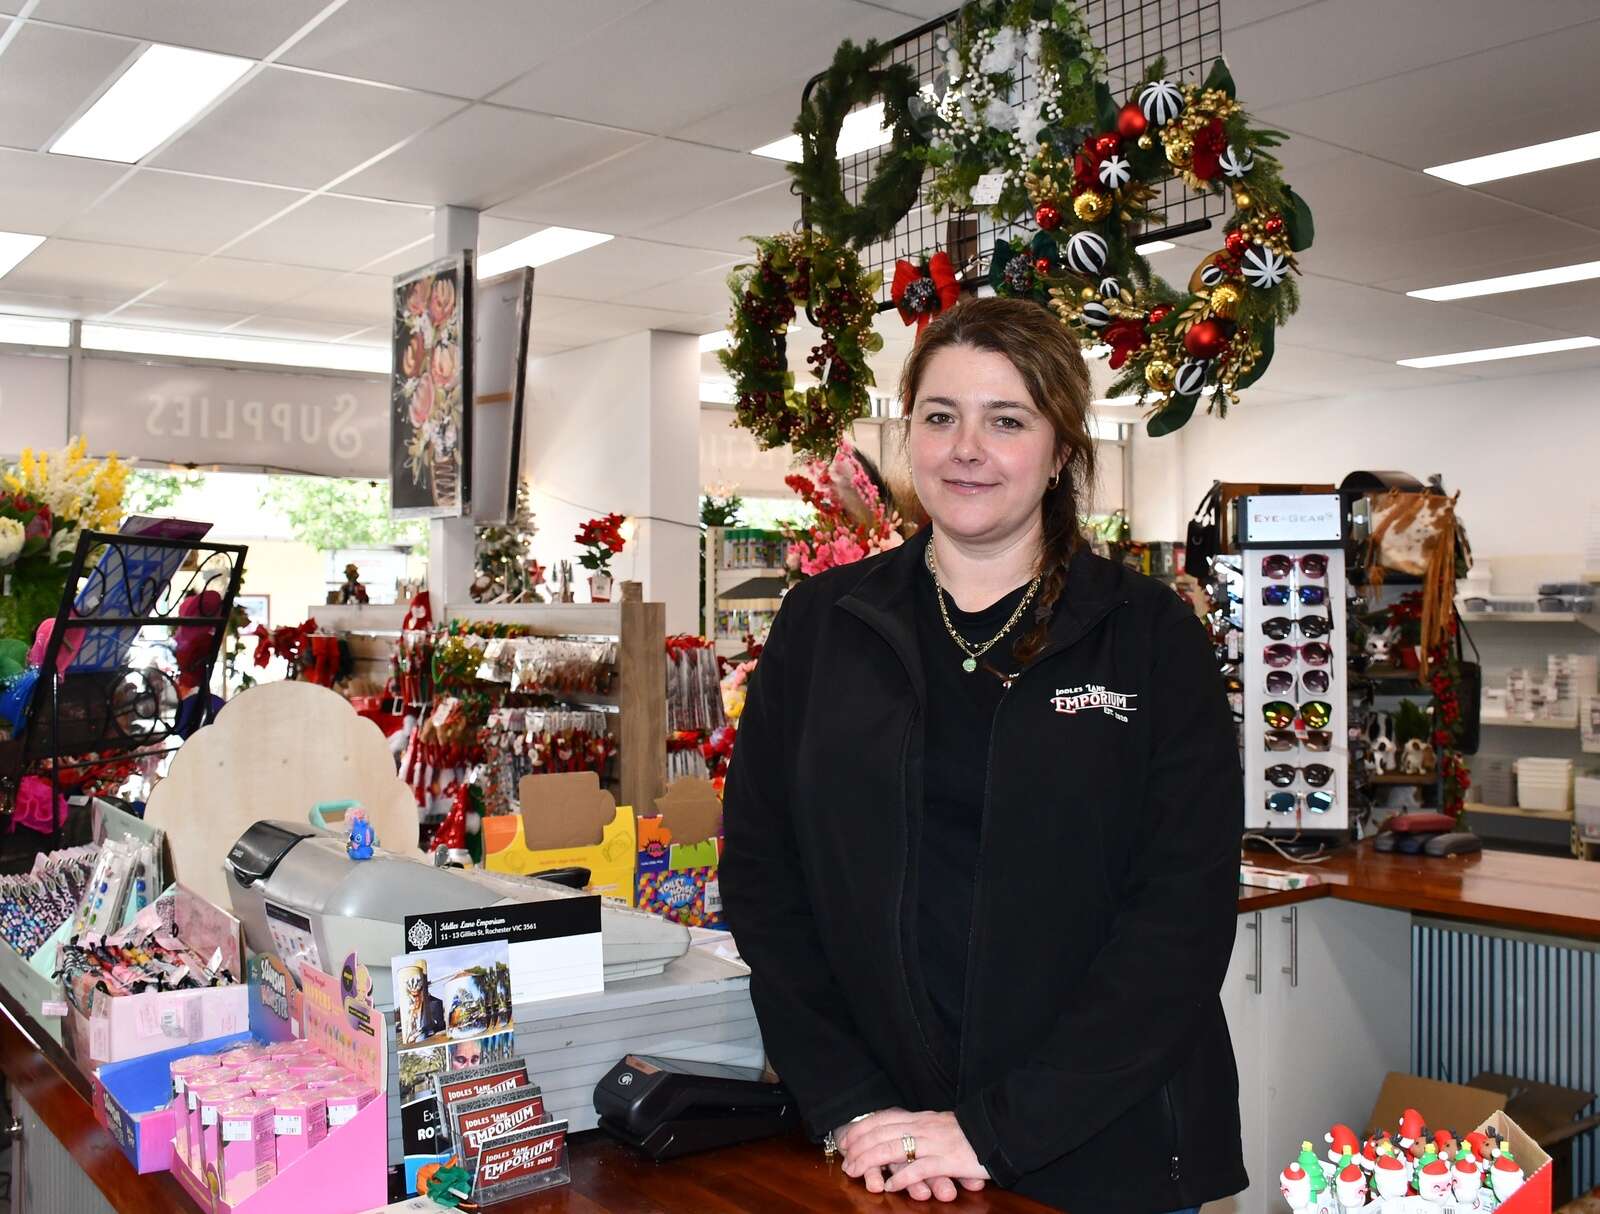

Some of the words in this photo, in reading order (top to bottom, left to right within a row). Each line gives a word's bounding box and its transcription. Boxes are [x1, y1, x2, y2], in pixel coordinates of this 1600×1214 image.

[1050, 694, 1127, 713] EMPORIUM
[476, 917, 506, 929] Emporium
[485, 926, 512, 935] Rochester
[523, 922, 537, 930] 3561
[463, 1105, 534, 1148] EMPORIUM
[465, 1117, 490, 1130] IDDLES
[481, 1139, 554, 1180] EMPORIUM
[486, 1150, 510, 1163] IDDLES
[537, 1156, 553, 1165] 2020
